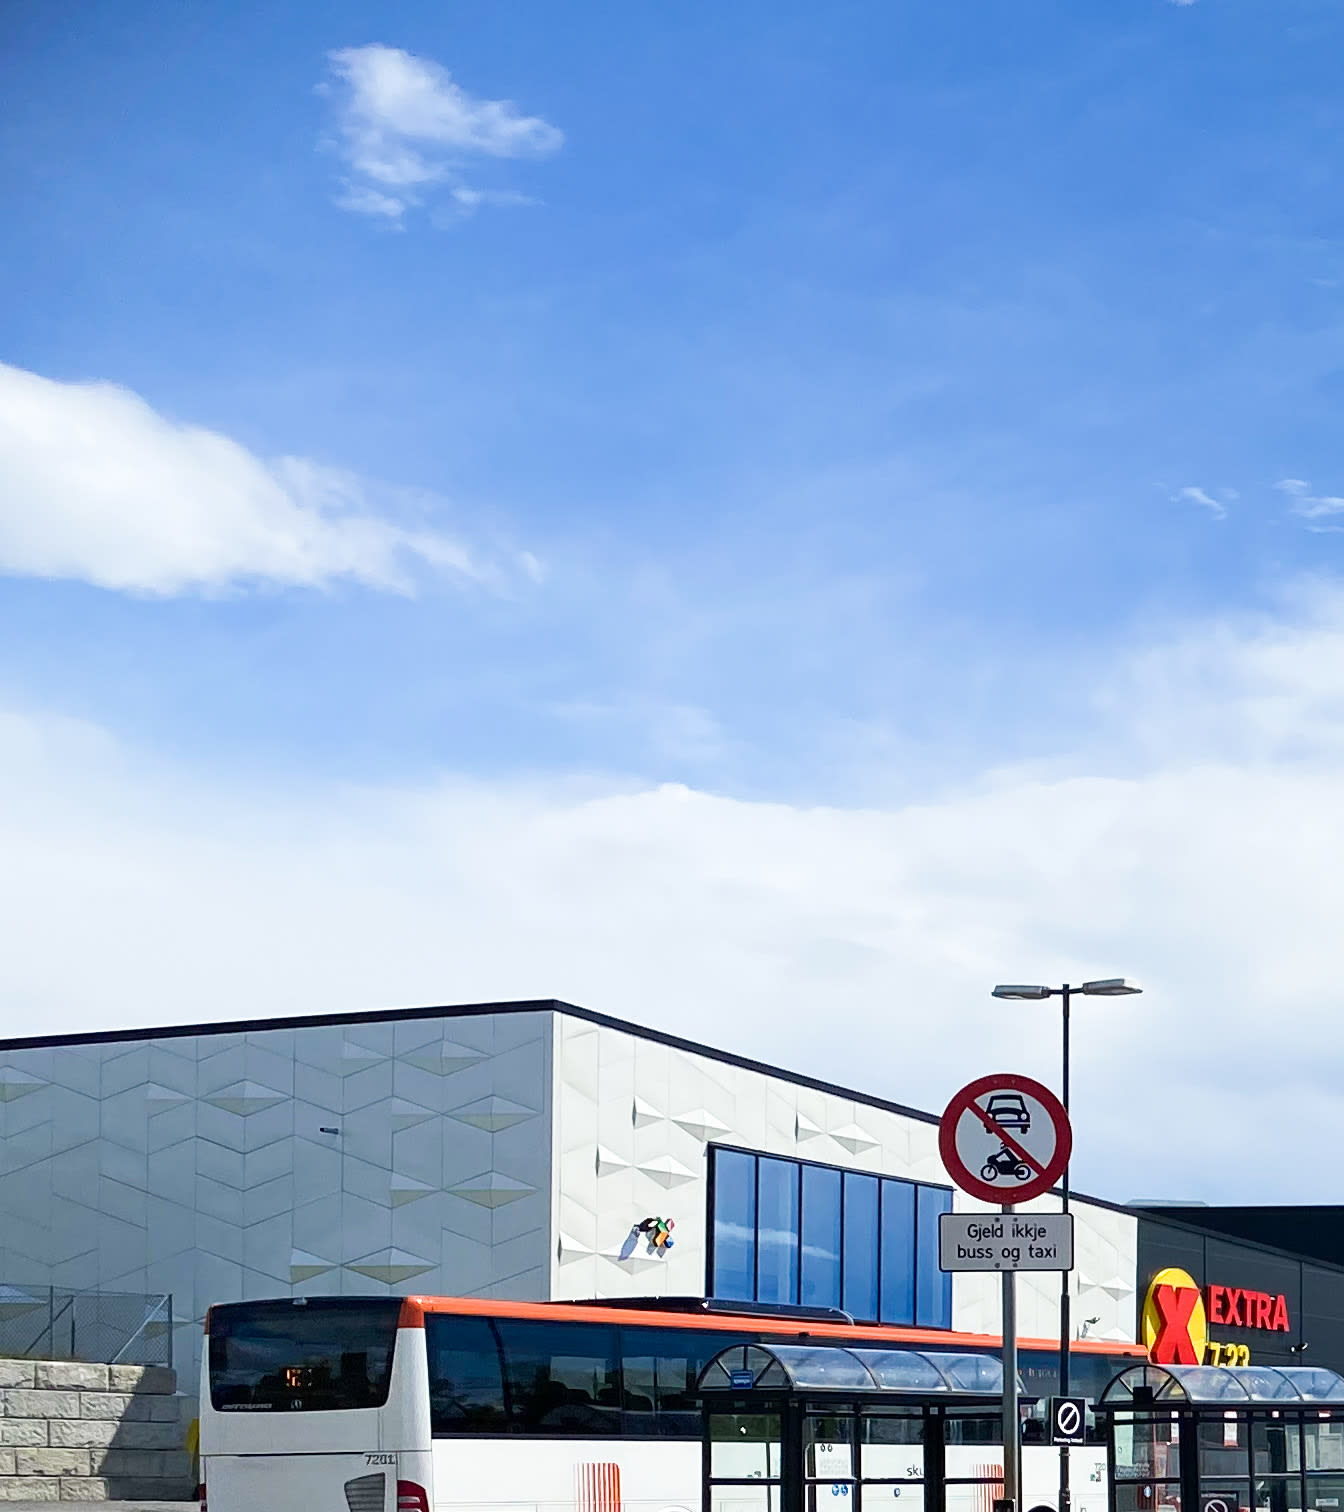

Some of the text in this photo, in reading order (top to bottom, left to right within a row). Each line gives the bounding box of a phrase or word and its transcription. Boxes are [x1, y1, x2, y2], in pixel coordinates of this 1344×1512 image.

[967, 1223, 1047, 1241] Gjeld ikkje
[957, 1244, 1057, 1262] buss og taxi
[1208, 1284, 1290, 1332] EXTRA
[365, 1454, 396, 1465] 7201
